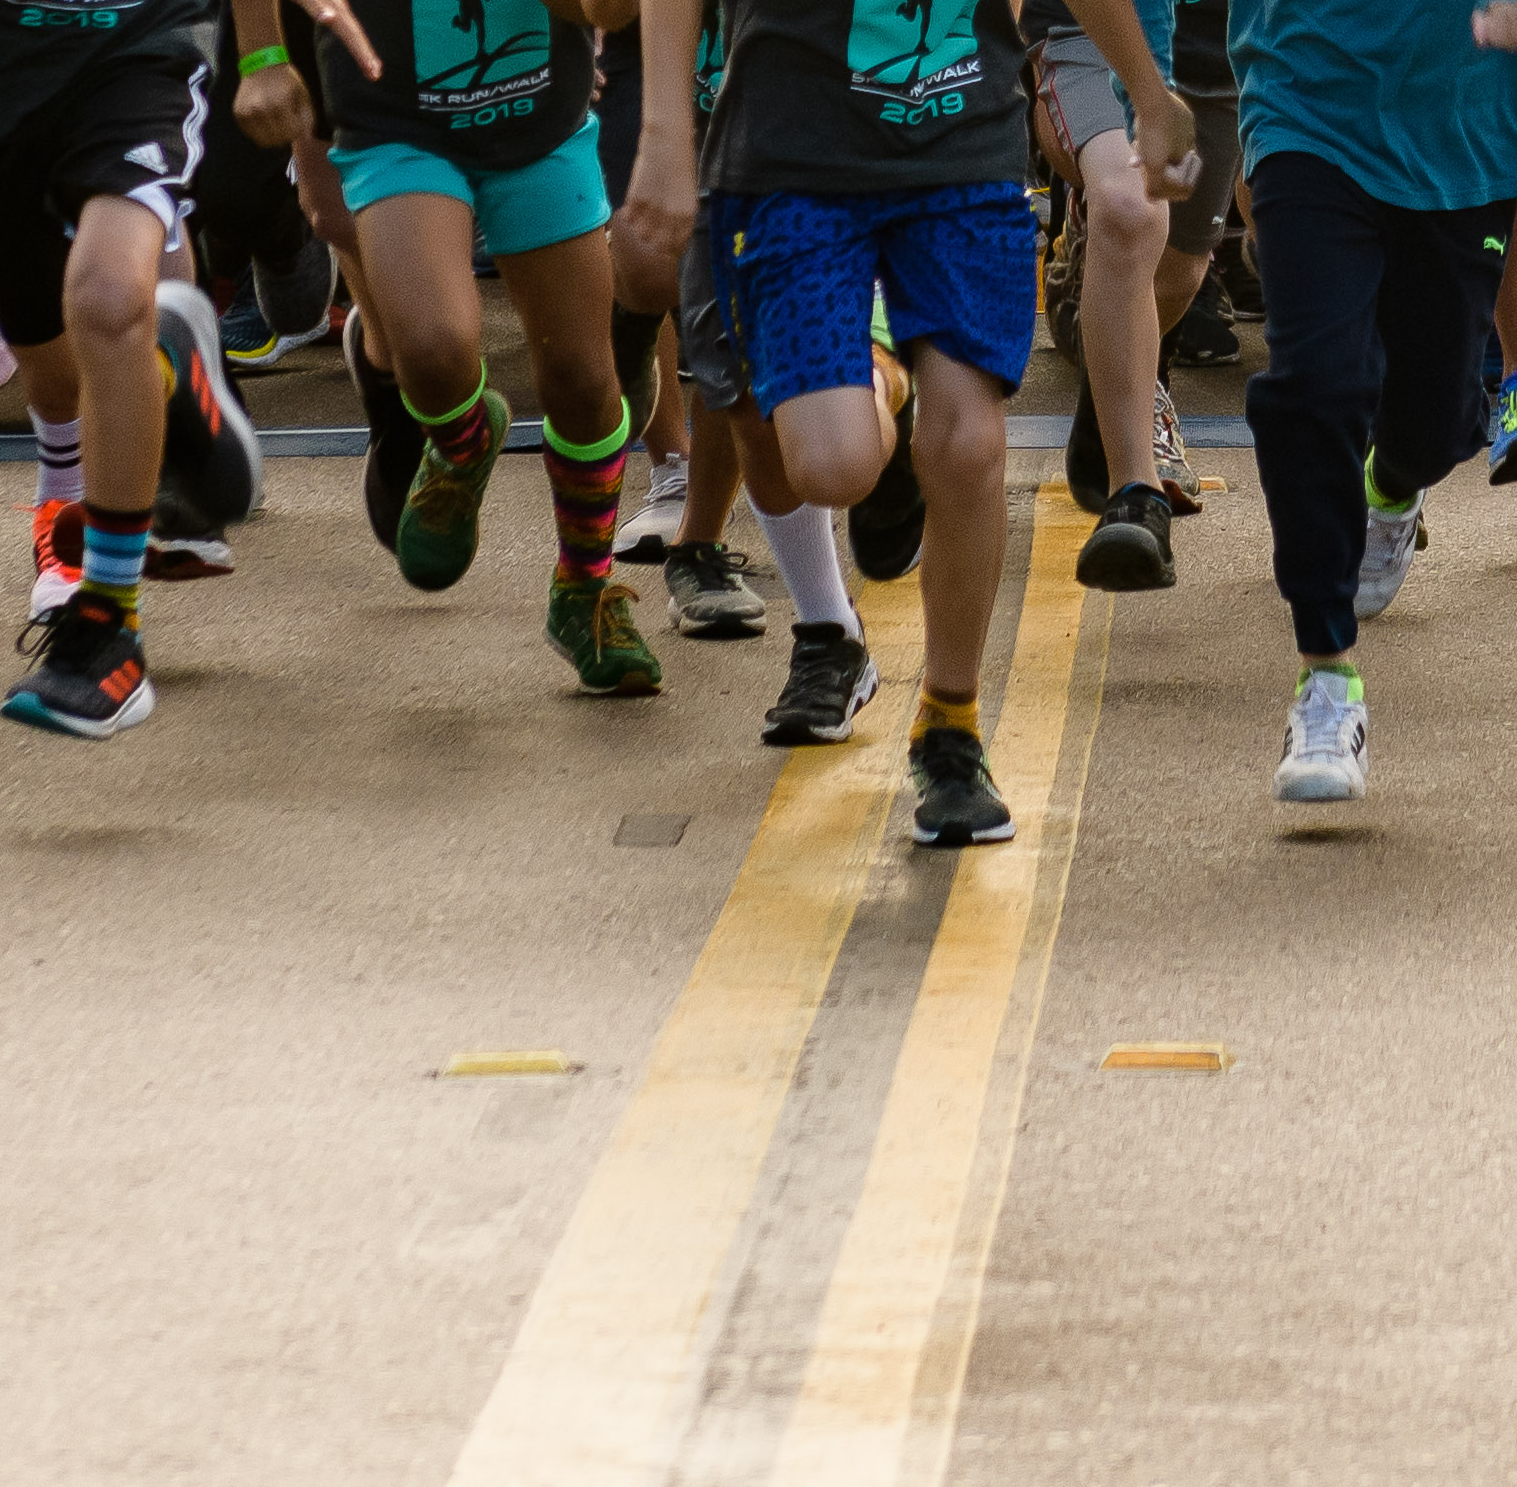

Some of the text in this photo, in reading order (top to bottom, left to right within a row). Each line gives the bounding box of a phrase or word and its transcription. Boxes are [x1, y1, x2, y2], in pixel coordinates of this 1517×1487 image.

[19, 8, 120, 29] 2019
[450, 98, 534, 130] 2019
[880, 91, 965, 126] 2019
